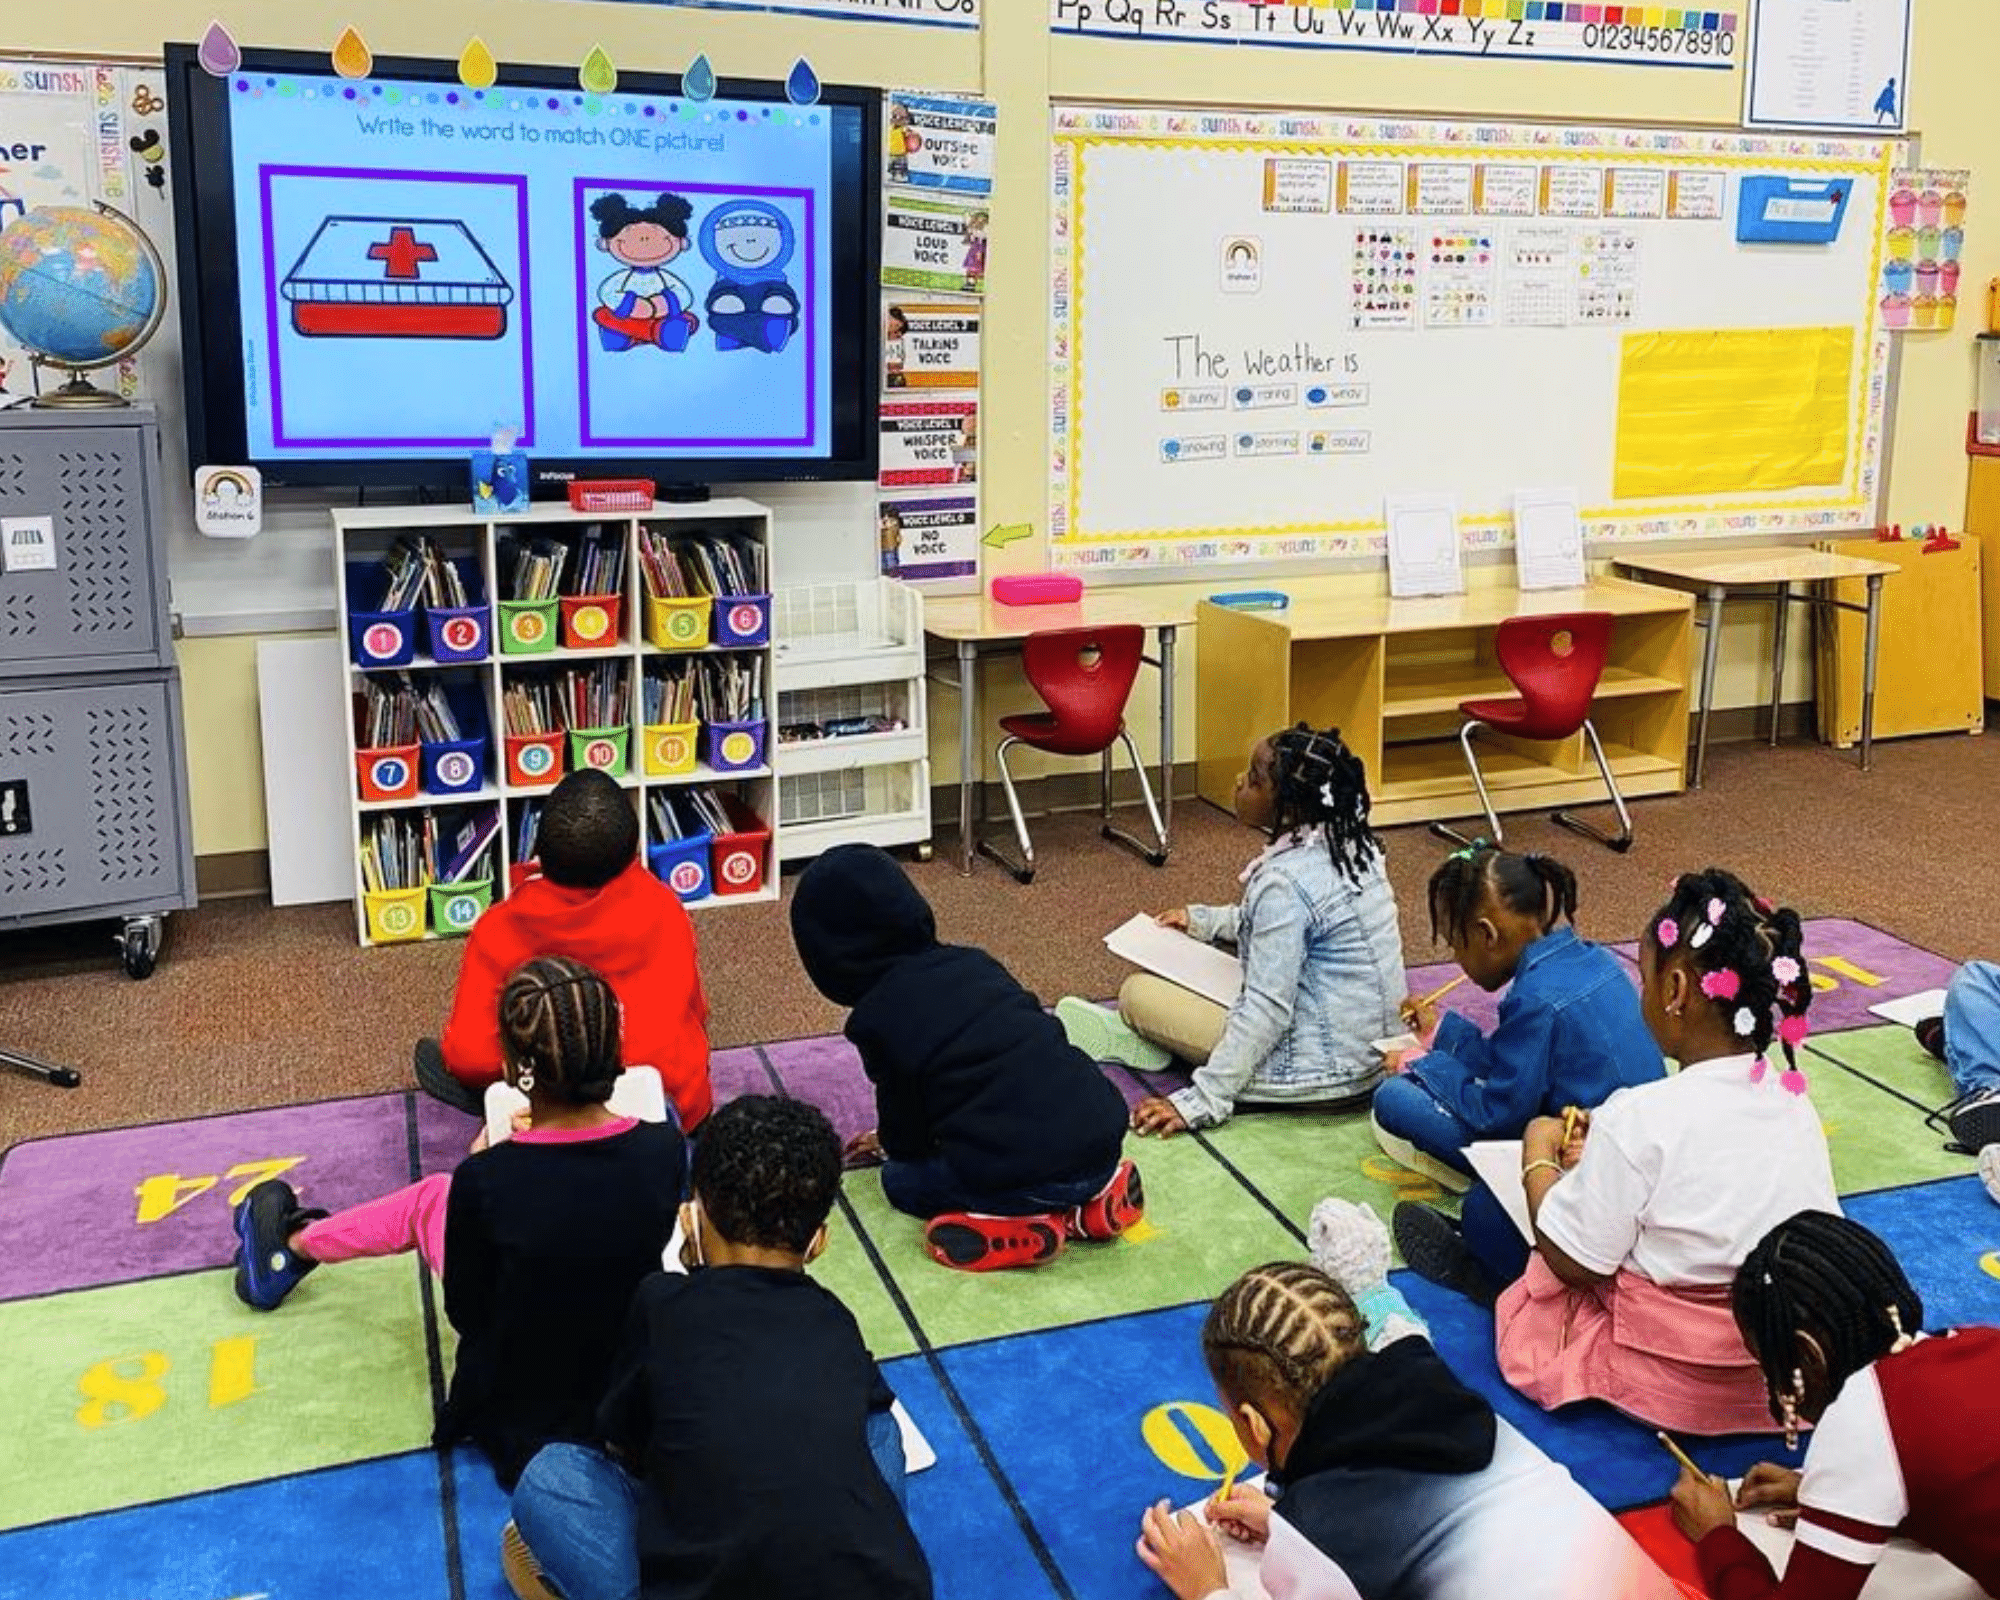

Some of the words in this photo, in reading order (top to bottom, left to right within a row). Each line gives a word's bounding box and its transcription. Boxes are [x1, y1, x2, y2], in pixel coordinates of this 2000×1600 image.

[1057, 0, 1091, 32] Pp
[1105, 0, 1143, 34] Qq
[1156, 0, 1186, 26] Rr
[1201, 1, 1231, 29] Ss
[1250, 4, 1276, 31] Tt
[1292, 5, 1324, 34] Uu
[1338, 10, 1365, 36] Vv
[1376, 12, 1414, 38] Ww
[1423, 15, 1453, 42] Xx
[1467, 17, 1495, 54] Yy
[1507, 19, 1535, 46] Zz
[356, 114, 415, 136] Write
[420, 117, 454, 139] the
[461, 121, 514, 141] word
[520, 122, 540, 142] to
[543, 126, 607, 146] match
[608, 127, 651, 149] ONE
[654, 131, 725, 153] picture!
[916, 236, 949, 249] LOUD
[1163, 333, 1229, 379] The
[1344, 352, 1360, 374] is
[207, 510, 245, 520] Station
[921, 530, 940, 541] NO
[456, 624, 468, 643] 2
[523, 619, 535, 636] 3
[677, 617, 690, 634] 5
[530, 749, 541, 767] 9
[592, 747, 610, 762] 10
[383, 764, 396, 783] 7
[454, 904, 472, 919] 14
